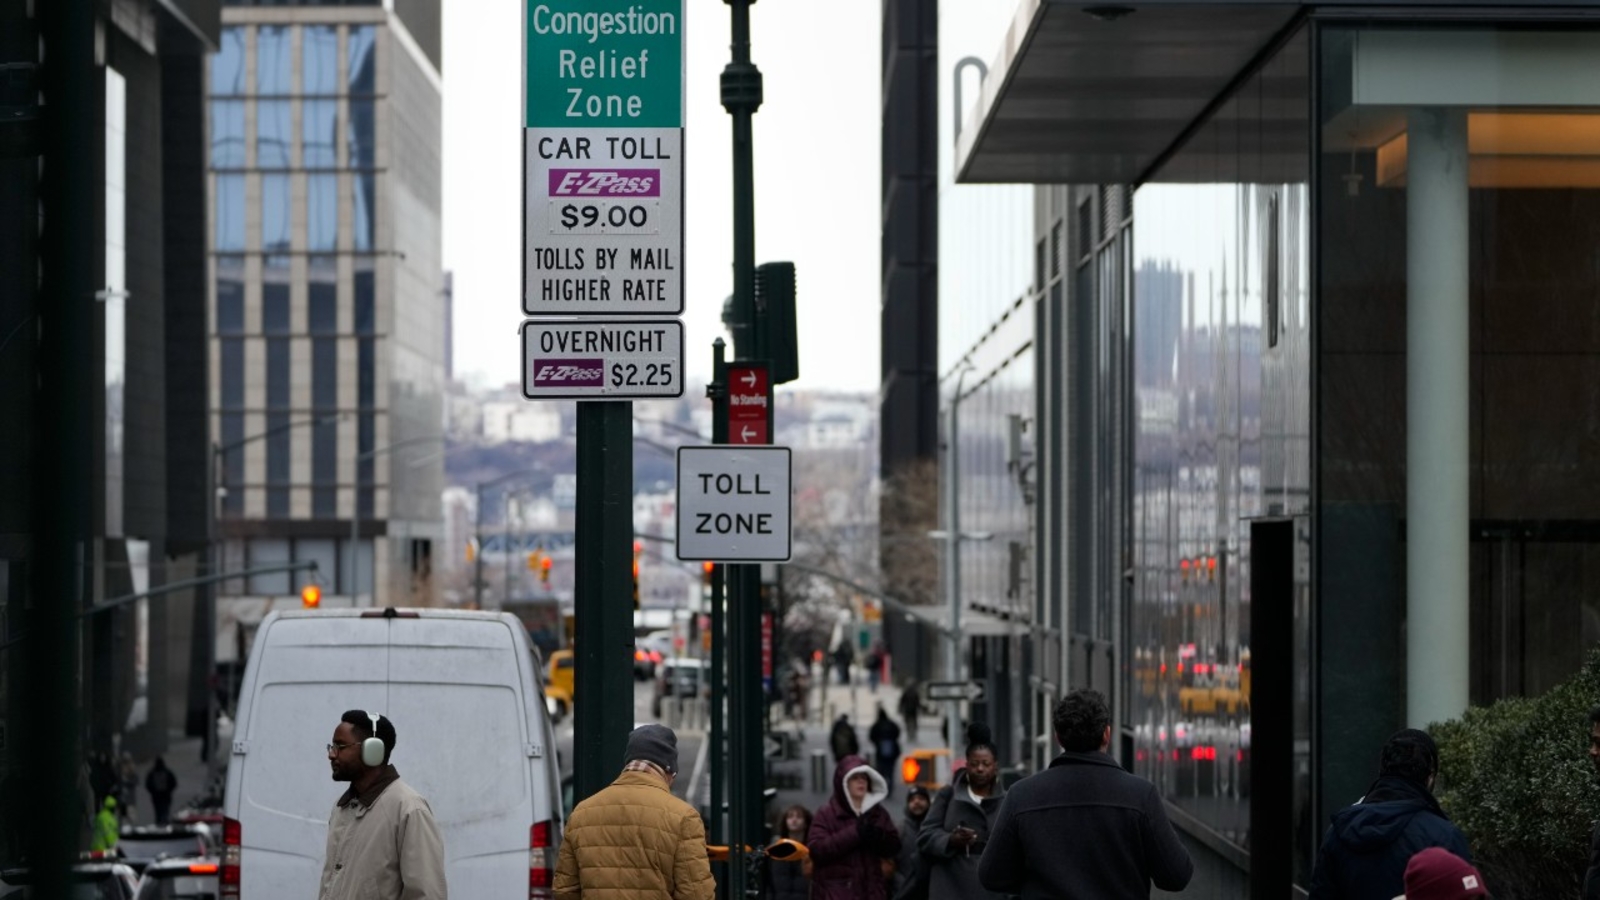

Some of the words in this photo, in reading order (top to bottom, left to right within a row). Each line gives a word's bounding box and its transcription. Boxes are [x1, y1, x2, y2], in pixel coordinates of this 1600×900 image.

[533, 4, 675, 43] Congestion
[559, 49, 649, 79] Relief
[565, 88, 642, 118] Zone
[538, 137, 591, 160] CAR
[606, 137, 671, 160] TOLL
[555, 171, 654, 195] E-ZPass
[561, 204, 647, 230] $9.00
[534, 248, 585, 270] TOLLS
[596, 248, 618, 270] BY
[630, 248, 674, 270] MAIL
[541, 279, 611, 301] HIGHER
[623, 279, 666, 301] RATE
[540, 330, 666, 353] OVERNIGHT
[534, 365, 603, 381] E-ZPass
[611, 362, 672, 388] $2.25
[730, 394, 740, 406] No
[740, 394, 767, 408] Standing
[698, 473, 771, 495] TOLL
[695, 513, 773, 534] ZONE
